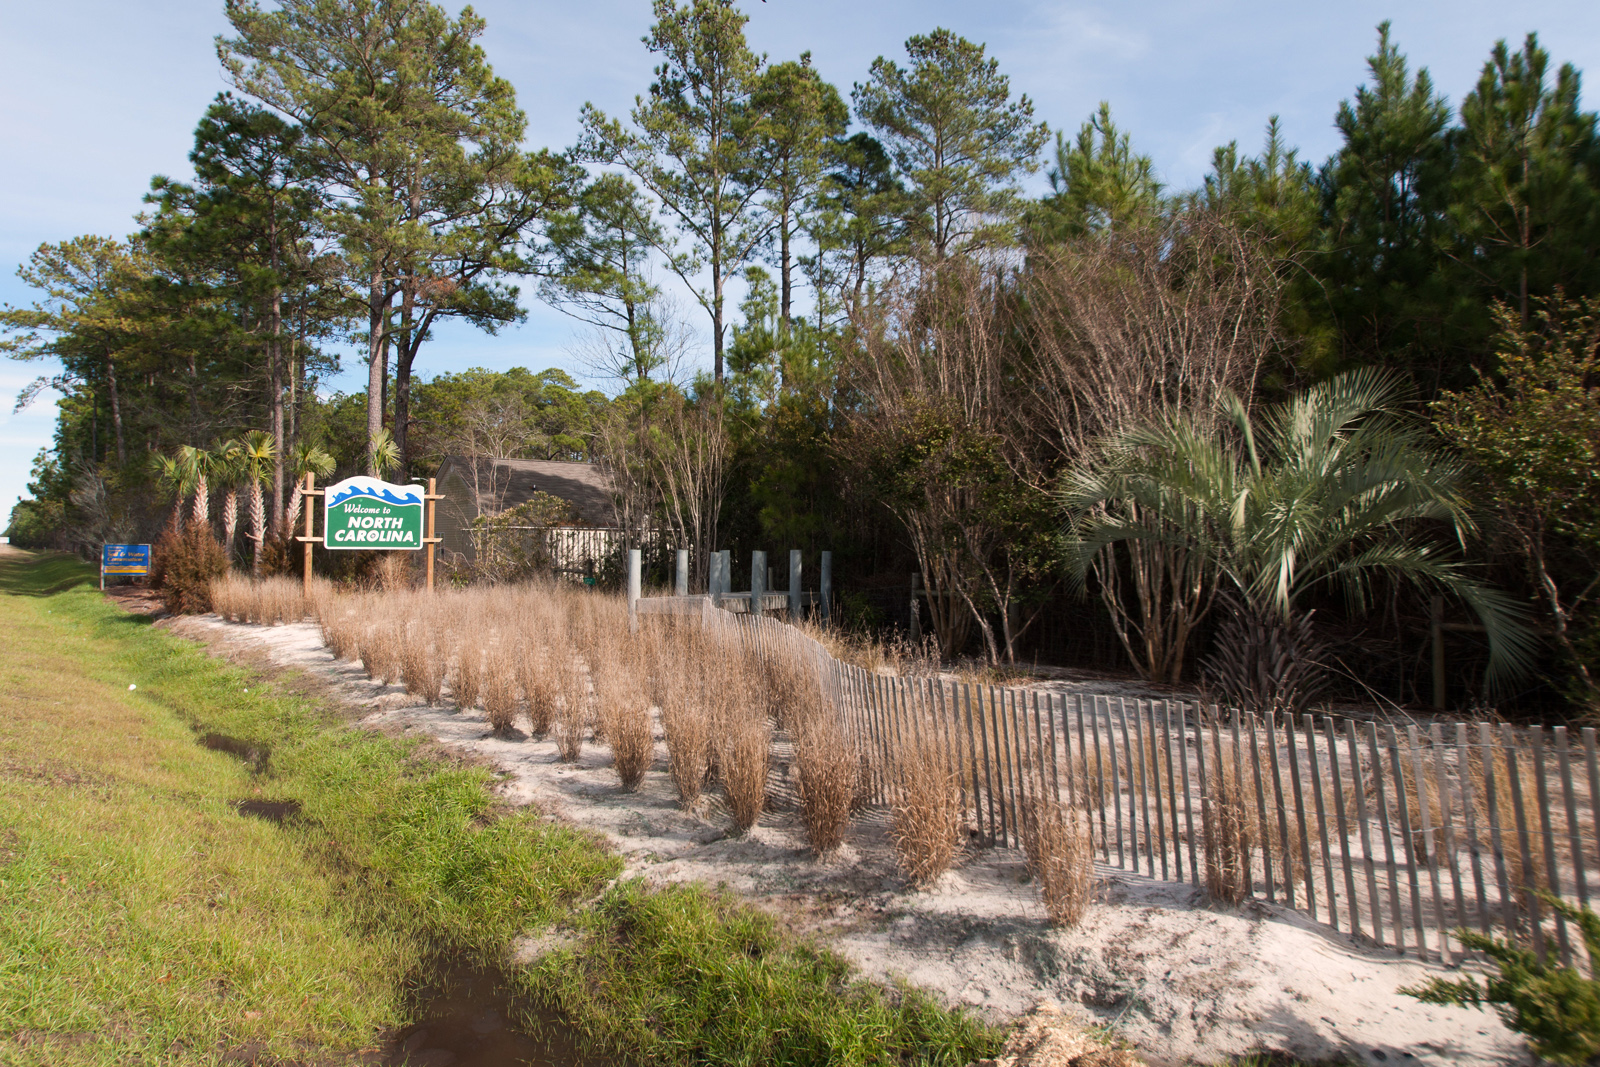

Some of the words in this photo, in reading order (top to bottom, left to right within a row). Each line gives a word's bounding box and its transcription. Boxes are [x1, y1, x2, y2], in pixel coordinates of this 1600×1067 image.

[344, 503, 380, 514] Welcome
[382, 506, 391, 514] to
[347, 516, 403, 529] NORTH
[334, 529, 414, 542] CAROLINA
